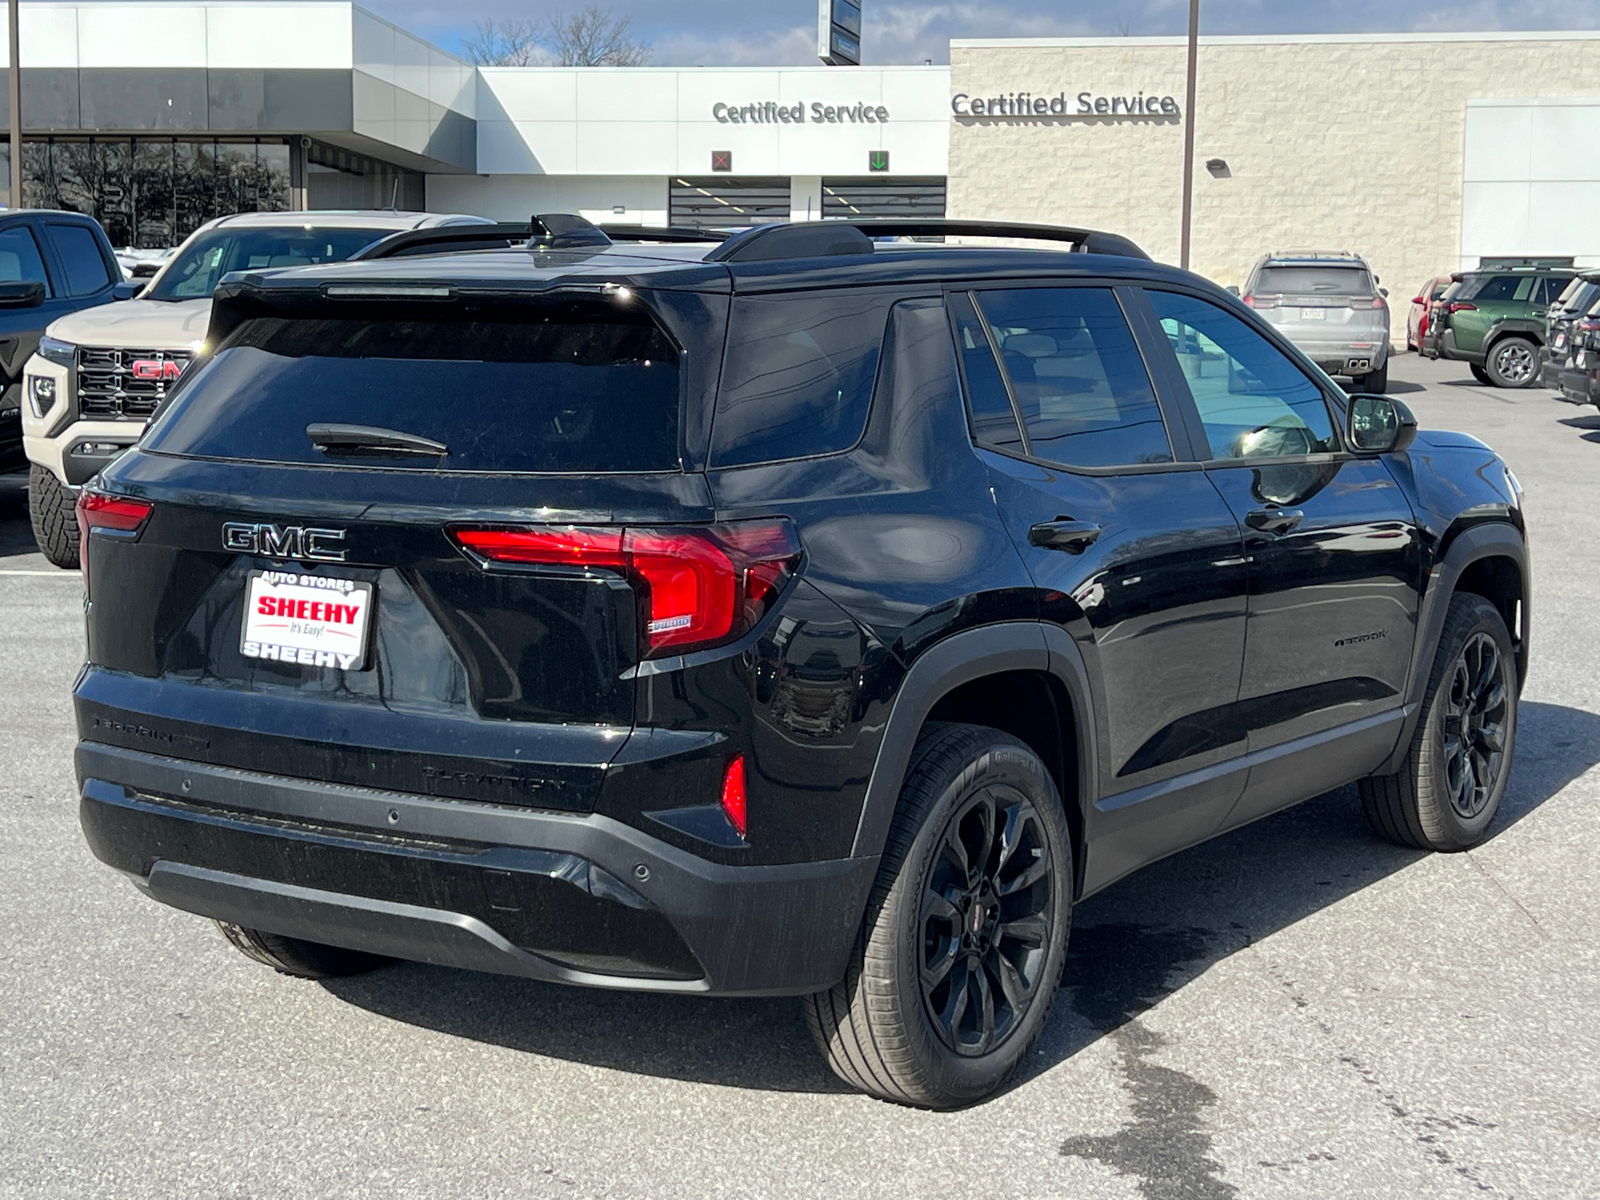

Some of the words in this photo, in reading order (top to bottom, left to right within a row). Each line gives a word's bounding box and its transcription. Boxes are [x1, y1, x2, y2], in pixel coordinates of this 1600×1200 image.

[713, 101, 805, 124] Certified
[810, 101, 890, 124] Service
[951, 91, 1066, 117] Certified
[1077, 91, 1177, 117] Service
[222, 521, 349, 562] GMC
[260, 570, 298, 585] AUTO
[299, 575, 355, 592] STORES
[257, 595, 361, 625] SHEEHY
[289, 621, 303, 635] It's
[303, 623, 325, 639] Easy!
[243, 640, 358, 671] SHEEHY
